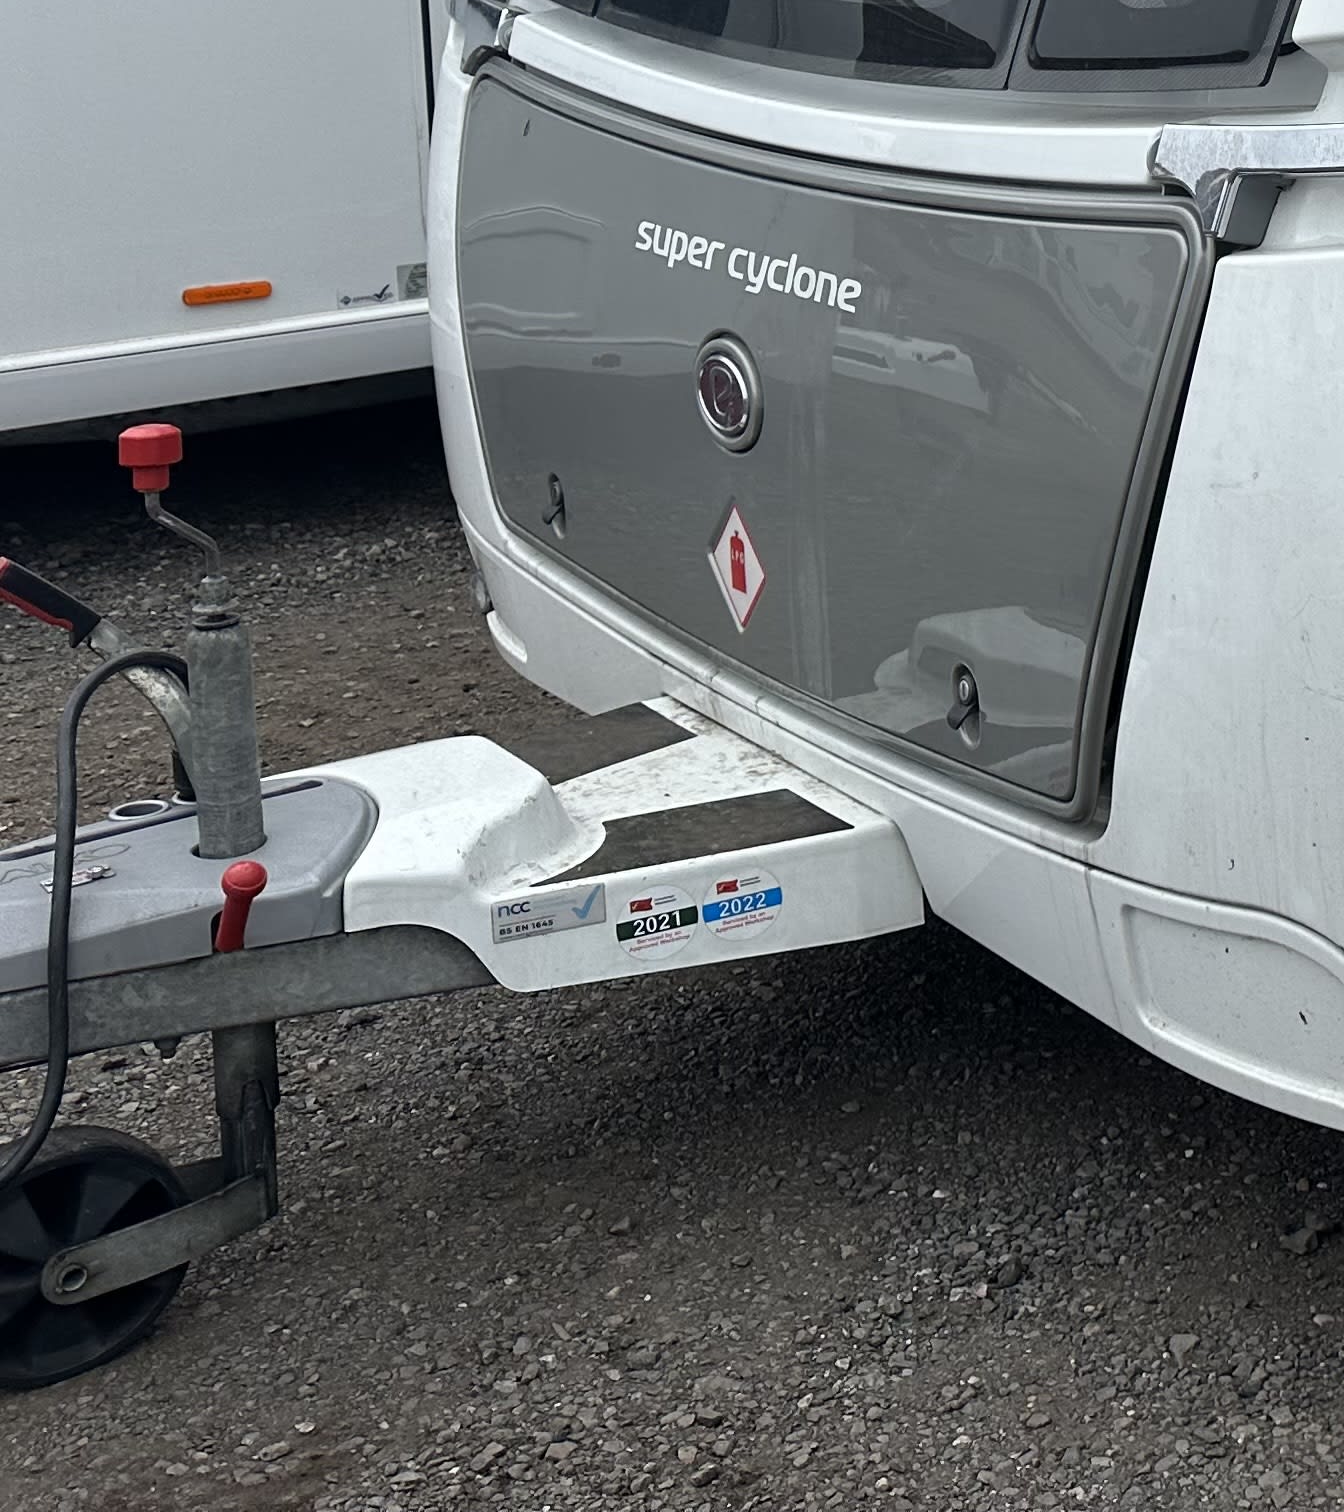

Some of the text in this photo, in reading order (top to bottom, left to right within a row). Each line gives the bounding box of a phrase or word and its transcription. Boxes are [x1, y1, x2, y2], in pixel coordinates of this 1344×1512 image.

[635, 220, 862, 313] super cyclone
[731, 548, 744, 565] LPG
[497, 901, 531, 918] ncc
[718, 892, 767, 918] 2022
[515, 924, 529, 933] EN
[633, 910, 681, 937] 2021
